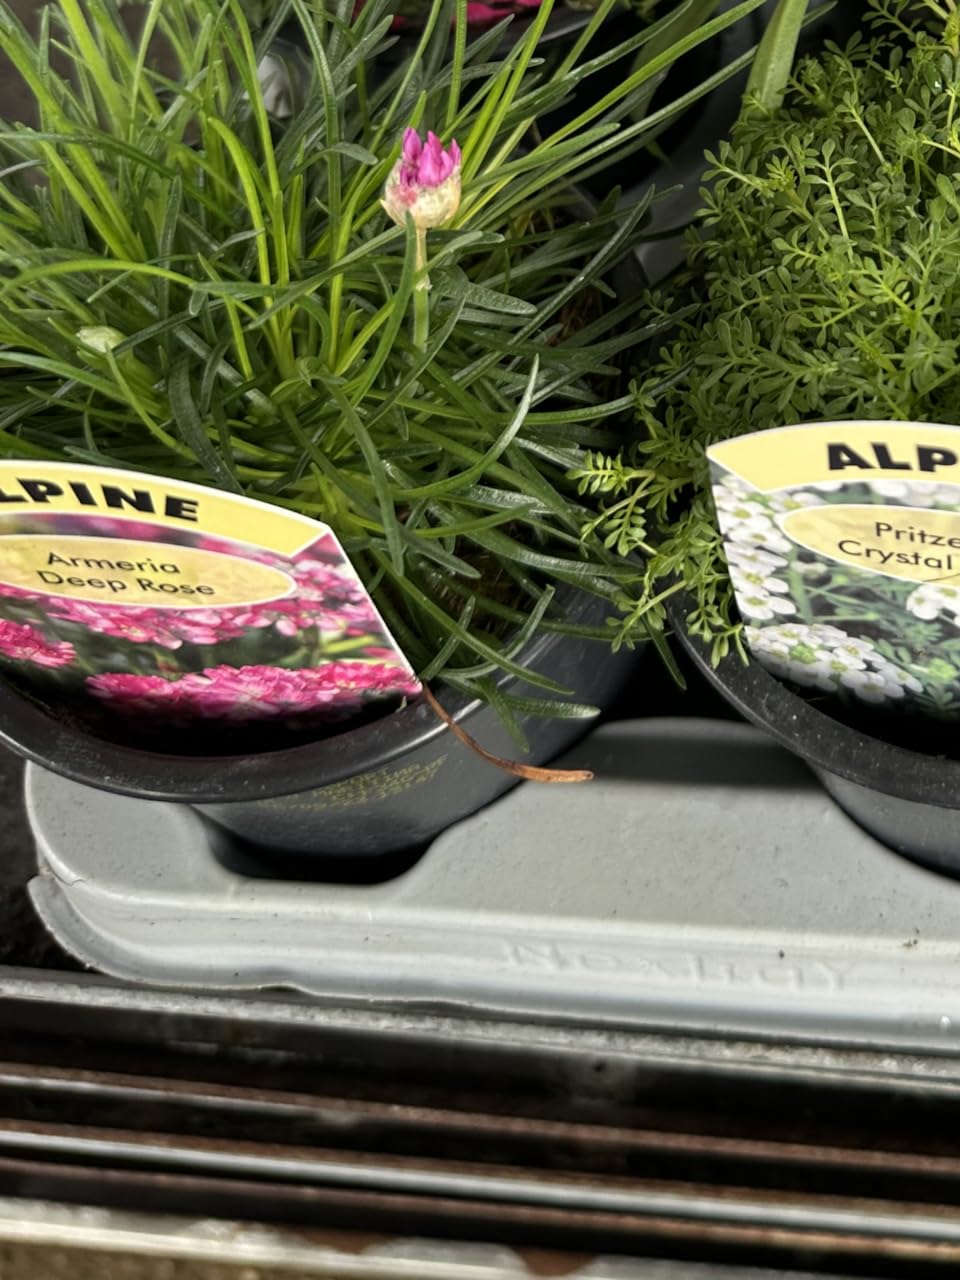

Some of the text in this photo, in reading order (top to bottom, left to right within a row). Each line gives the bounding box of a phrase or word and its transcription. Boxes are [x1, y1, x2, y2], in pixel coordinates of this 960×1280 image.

[47, 551, 182, 575] Armeria
[837, 539, 953, 570] Crystal
[37, 570, 217, 597] Deep Rose
